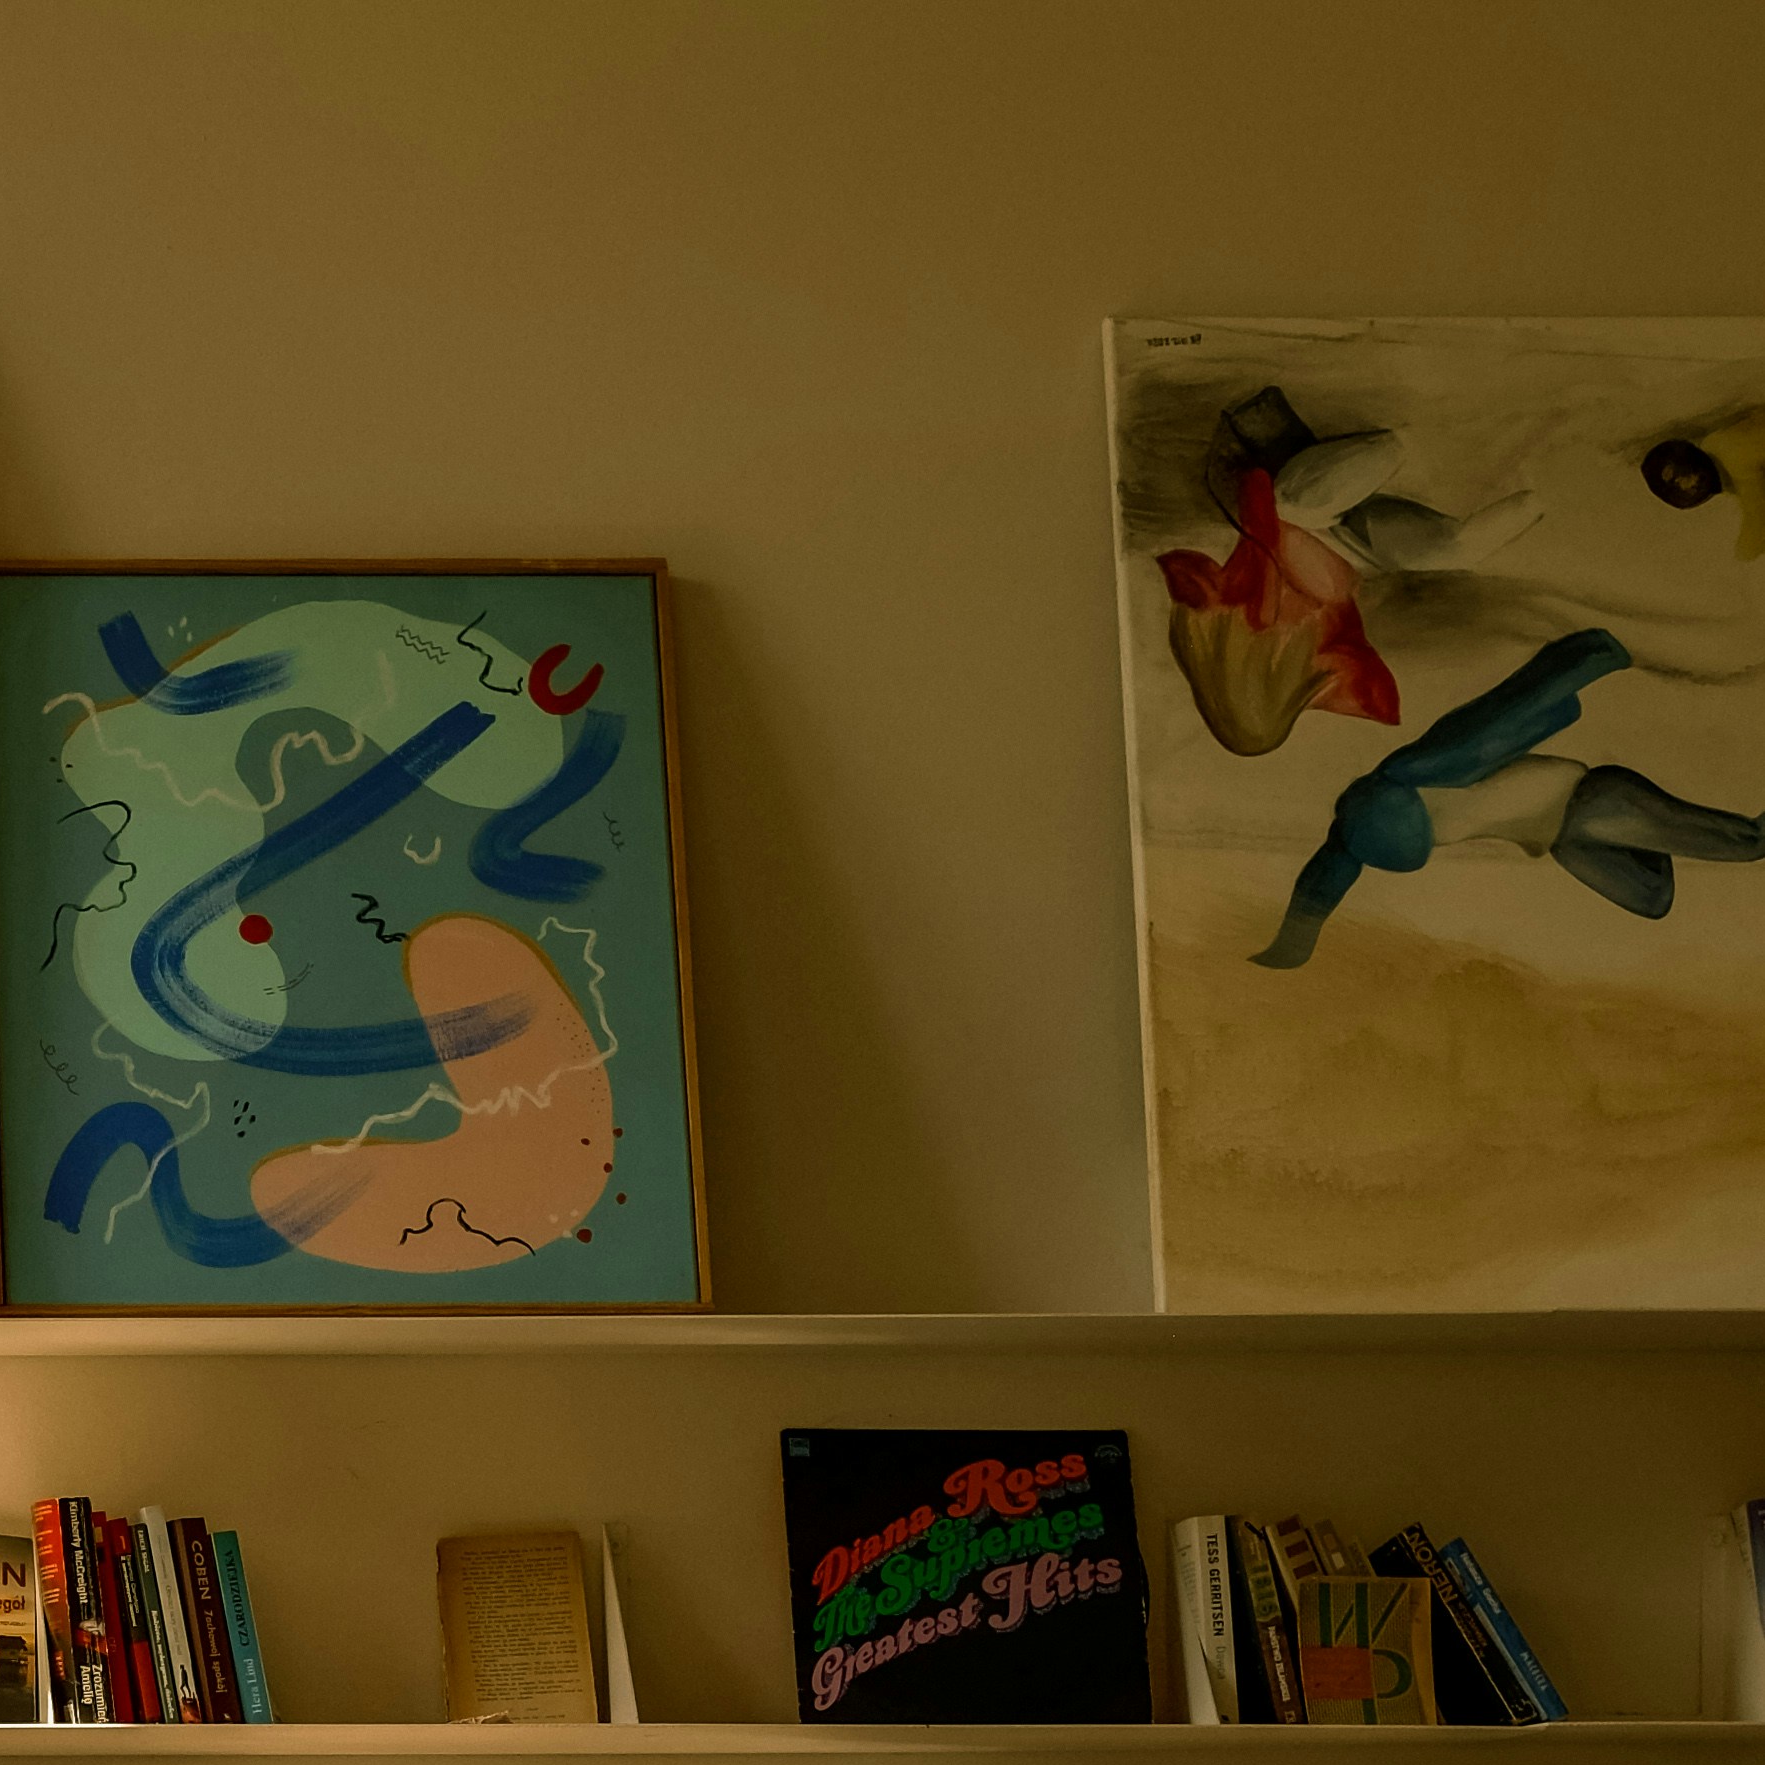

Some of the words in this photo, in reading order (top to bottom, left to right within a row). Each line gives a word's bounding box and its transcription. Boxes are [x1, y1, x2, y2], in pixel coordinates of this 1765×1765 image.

[66, 1500, 82, 1548] Kimberly
[811, 1504, 937, 1607] Diana
[943, 1454, 1087, 1518] Ross
[875, 1502, 1105, 1616] Supremes
[1206, 1534, 1219, 1564] TESS
[70, 1549, 88, 1606] McCreight
[223, 1548, 250, 1647] CZARODZIEJKA
[1407, 1531, 1459, 1603] NERON
[190, 1538, 212, 1601] COBEN
[210, 1659, 227, 1694] spokój
[811, 1591, 985, 1713] Greatest
[981, 1551, 1123, 1632] Hits
[1208, 1568, 1224, 1637] GERRITSEN
[242, 1657, 257, 1684] Lind
[247, 1685, 262, 1714] Hera
